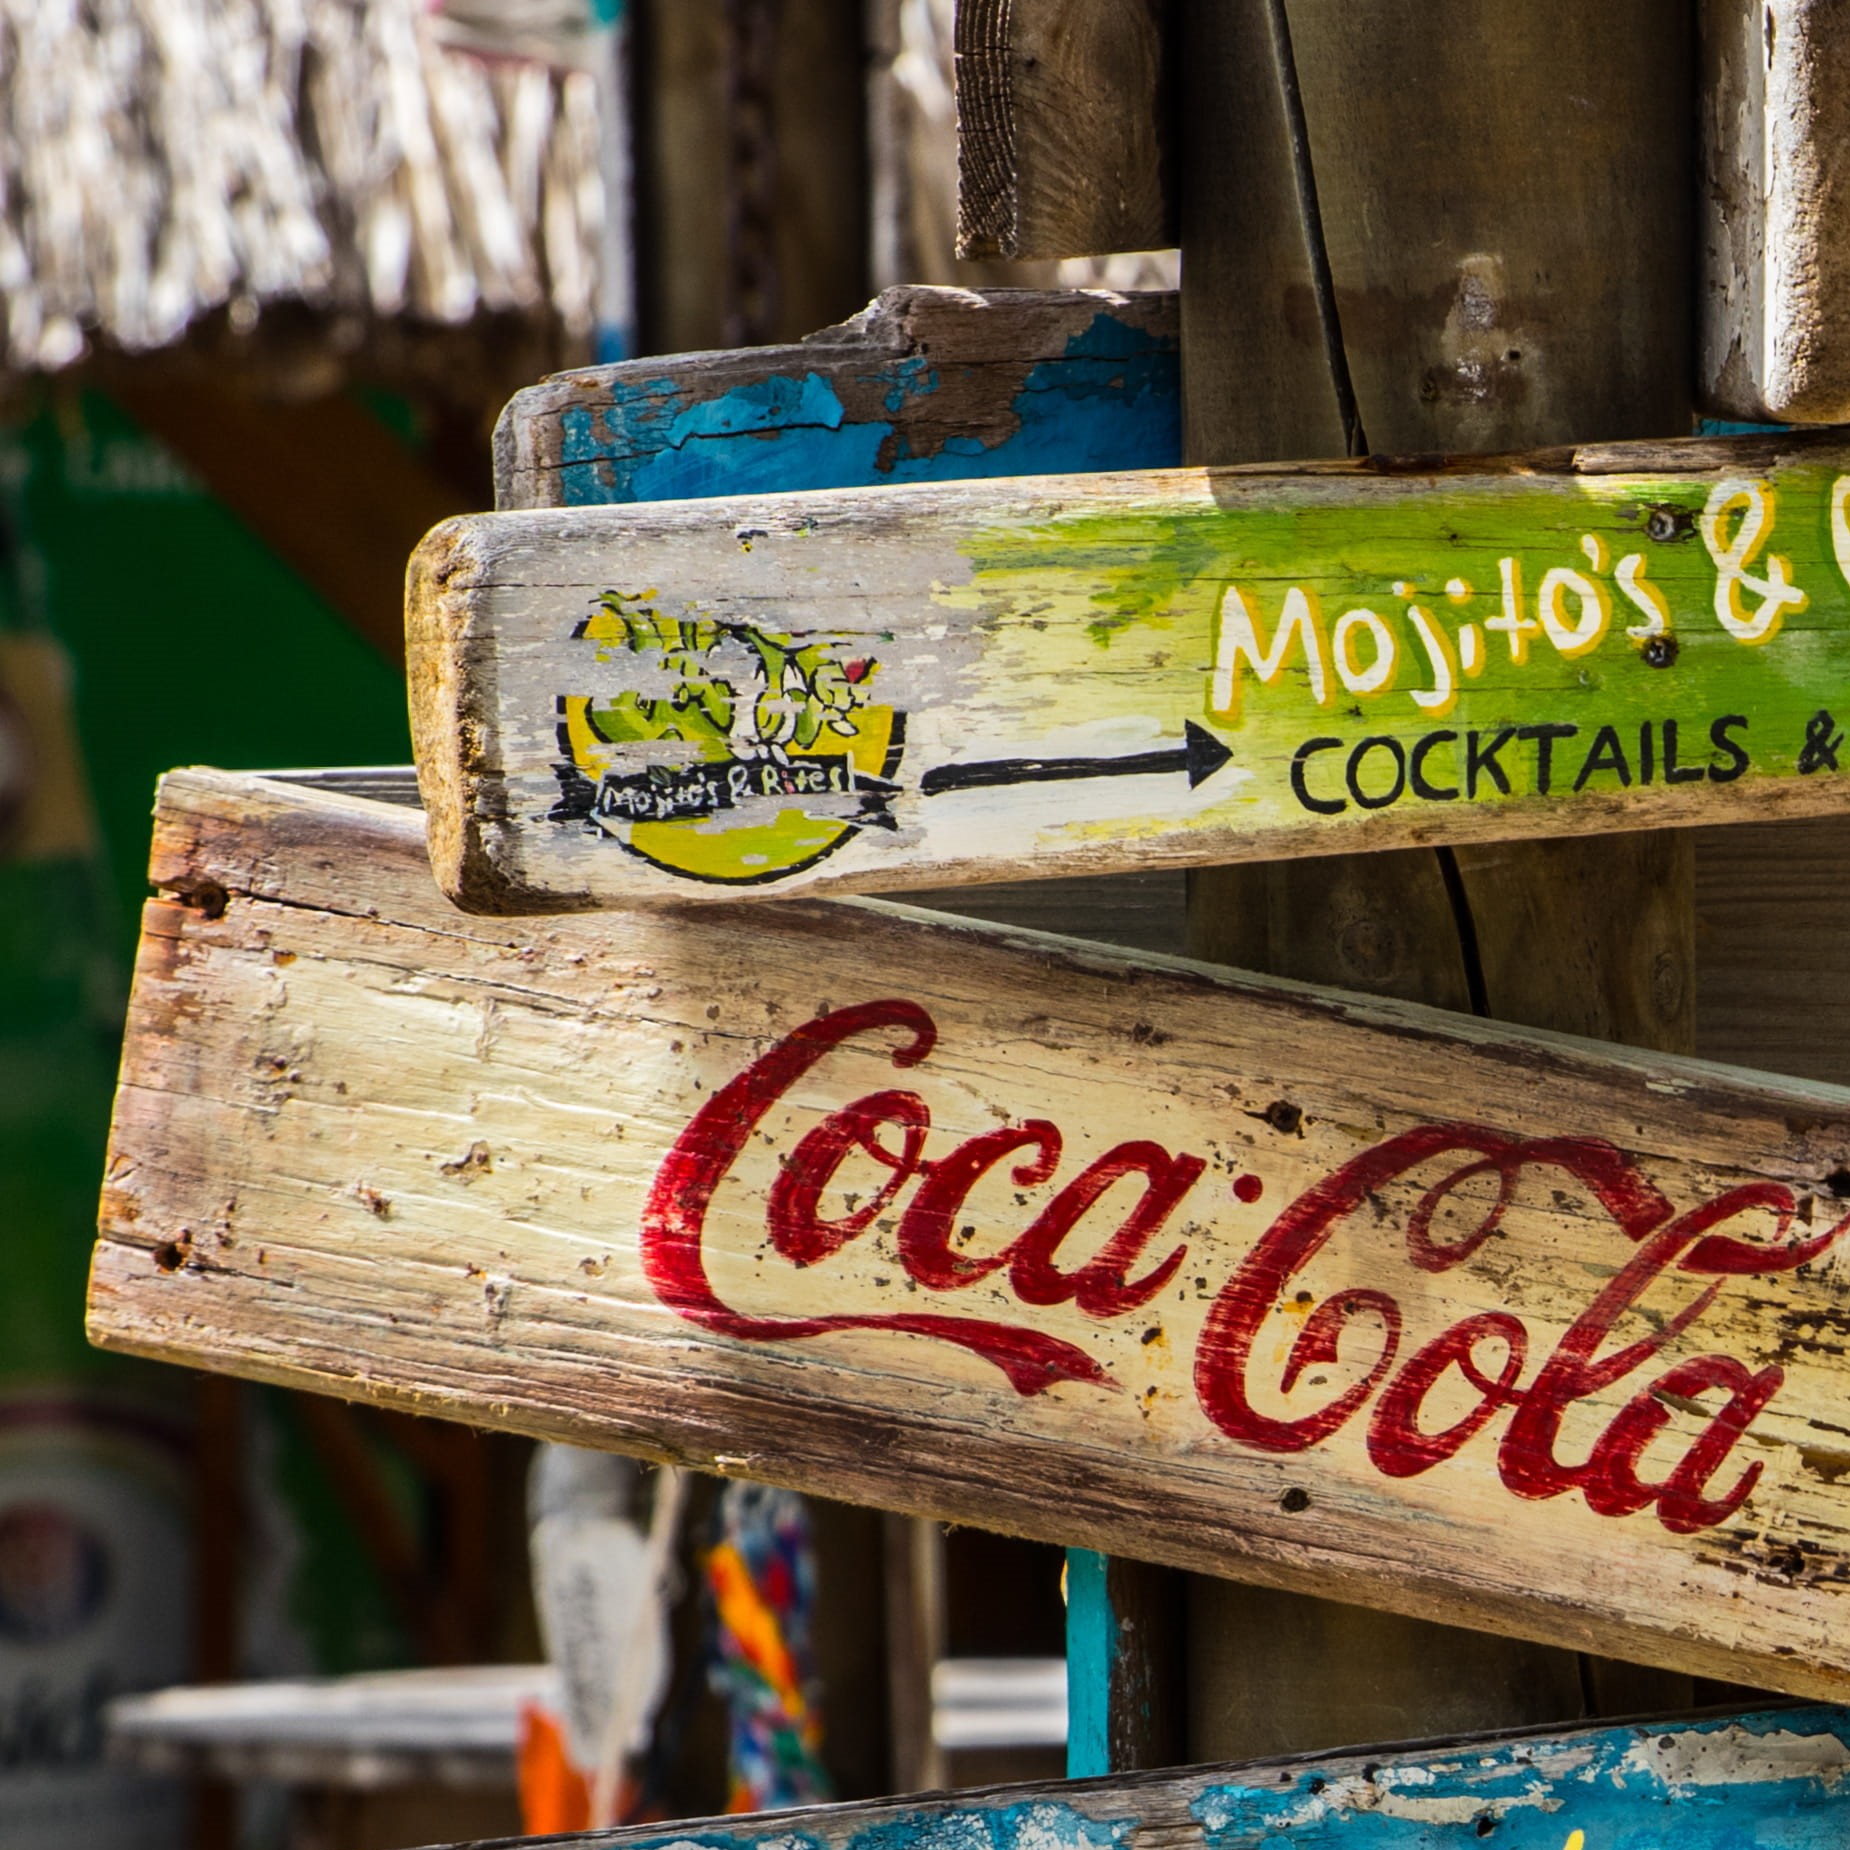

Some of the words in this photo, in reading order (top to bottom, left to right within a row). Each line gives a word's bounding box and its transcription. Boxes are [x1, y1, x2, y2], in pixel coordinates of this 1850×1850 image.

[1208, 533, 1672, 724] Mojito's
[1698, 477, 1807, 643] &
[1290, 714, 1750, 814] COCKTAILS
[1799, 709, 1843, 774] &
